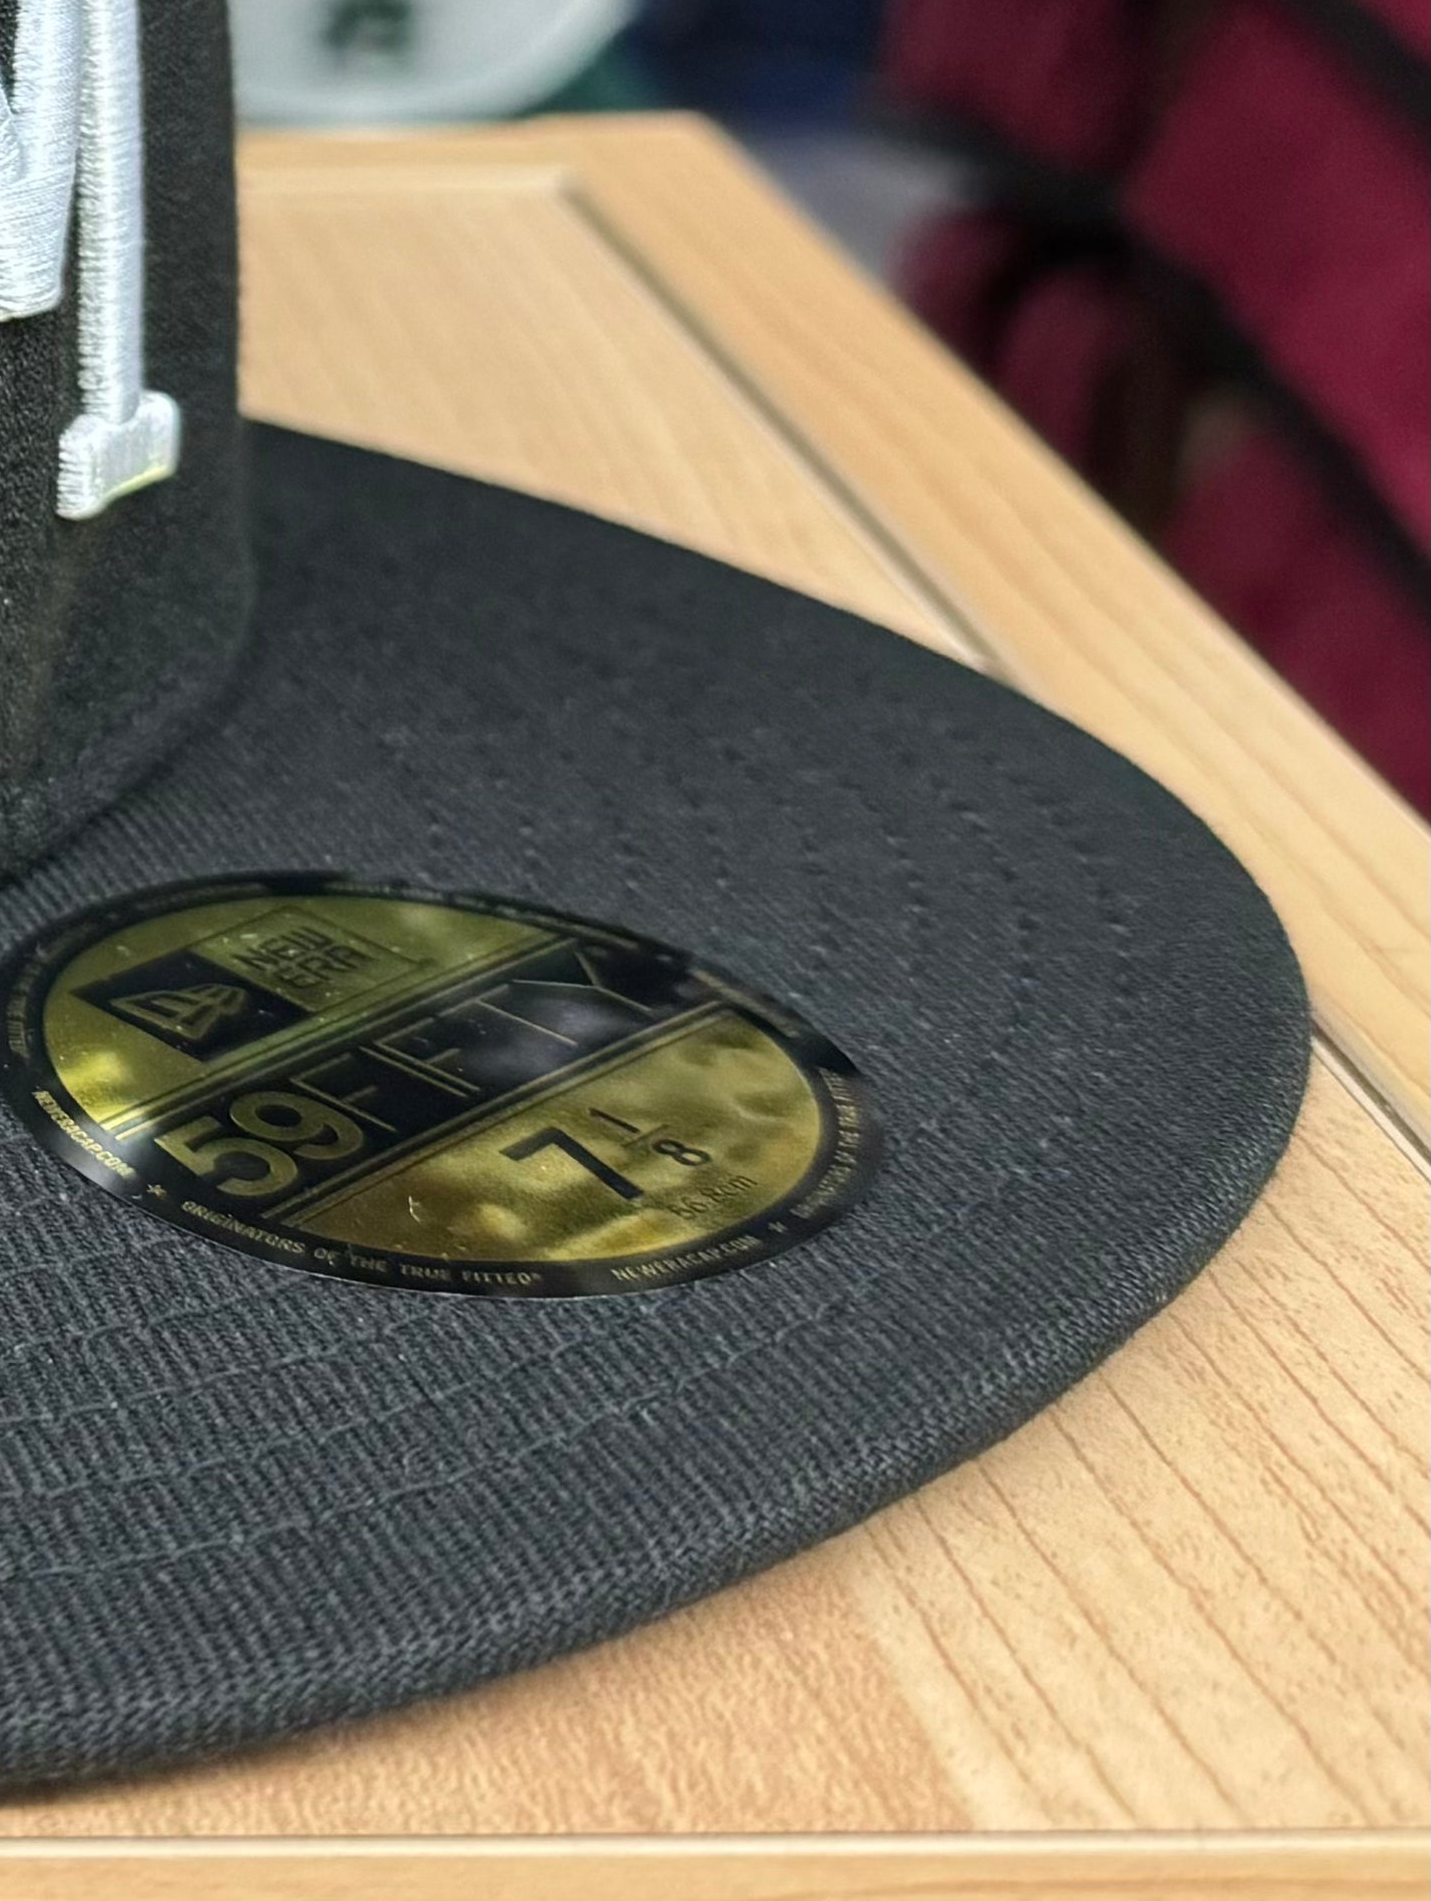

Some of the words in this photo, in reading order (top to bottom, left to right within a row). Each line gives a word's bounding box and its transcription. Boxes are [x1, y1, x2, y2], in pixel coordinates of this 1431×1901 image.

[230, 926, 335, 971] NEW
[274, 945, 380, 989] ERA
[153, 949, 654, 1197] 59FIFTY
[500, 1125, 644, 1200] 7
[180, 1199, 306, 1255] ORIGINATORS
[349, 1253, 388, 1274] THE
[400, 1263, 452, 1282] TRUE
